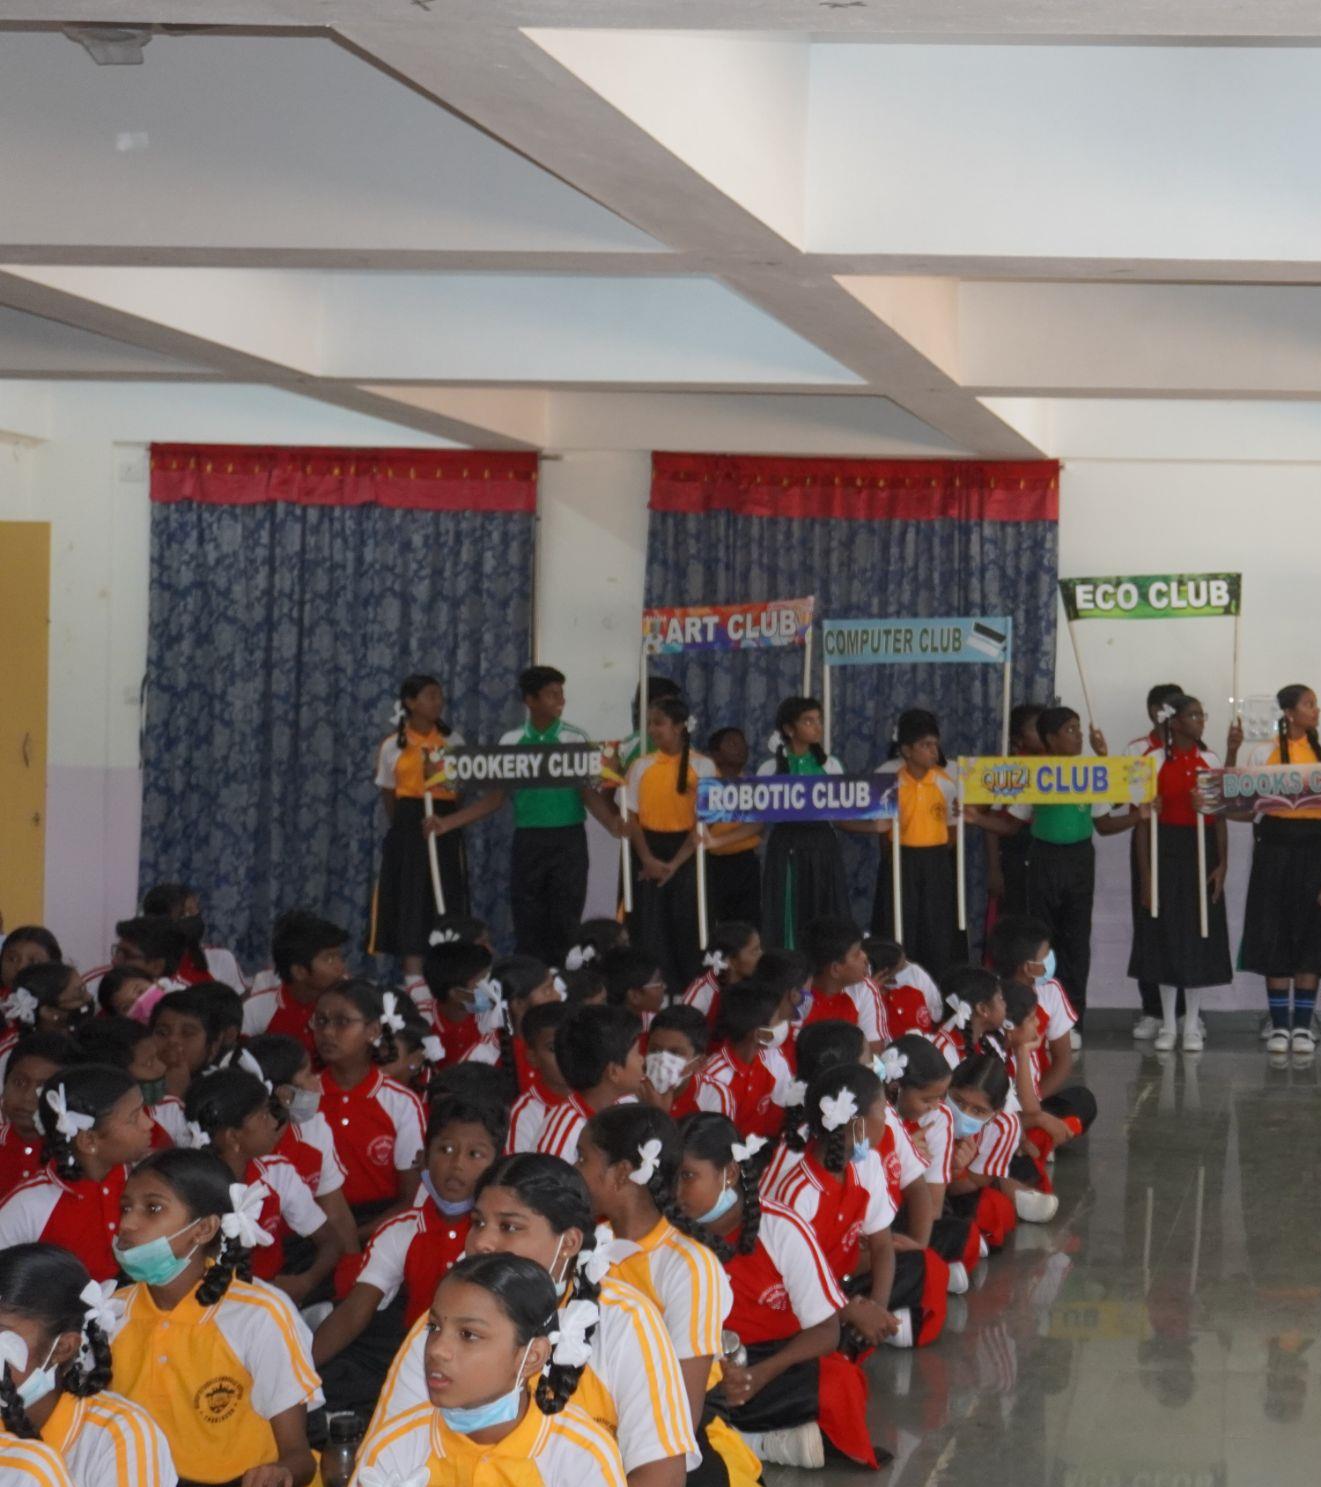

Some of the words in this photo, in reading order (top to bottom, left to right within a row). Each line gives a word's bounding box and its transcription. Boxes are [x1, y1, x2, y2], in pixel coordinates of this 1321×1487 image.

[1075, 583, 1139, 611] ECO
[1148, 579, 1230, 610] CLUB
[664, 616, 720, 645] ART
[727, 609, 797, 641] CLUB
[824, 628, 914, 656] COMPUTER
[918, 627, 962, 653] CLUB
[444, 753, 543, 780] COOKERY
[548, 752, 604, 777] CLUB
[1036, 765, 1109, 794] CLUB
[708, 782, 806, 811] ROBOTIC
[811, 780, 871, 809] CLUB
[1223, 772, 1304, 799] BOOKS
